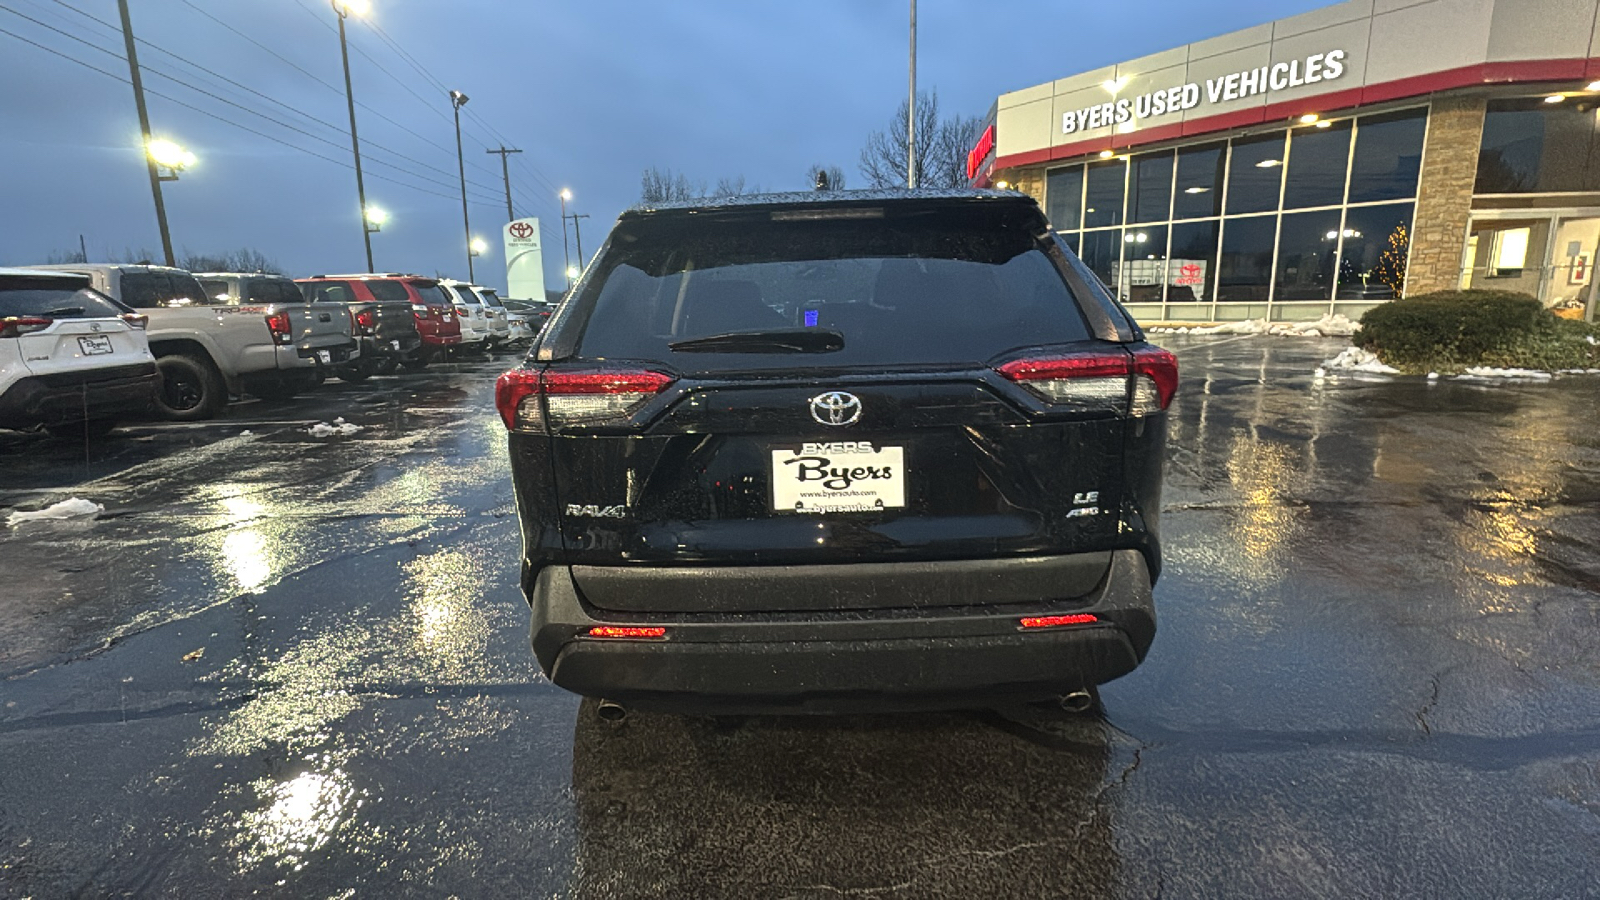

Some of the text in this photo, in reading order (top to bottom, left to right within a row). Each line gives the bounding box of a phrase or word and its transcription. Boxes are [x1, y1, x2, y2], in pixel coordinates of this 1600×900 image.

[1062, 50, 1345, 134] BYERS USED VEHICLES
[802, 441, 873, 455] BYERS
[783, 456, 892, 490] Byers
[800, 489, 877, 499] www.byersauto.com
[1073, 491, 1099, 504] LE
[565, 503, 626, 518] RAV4
